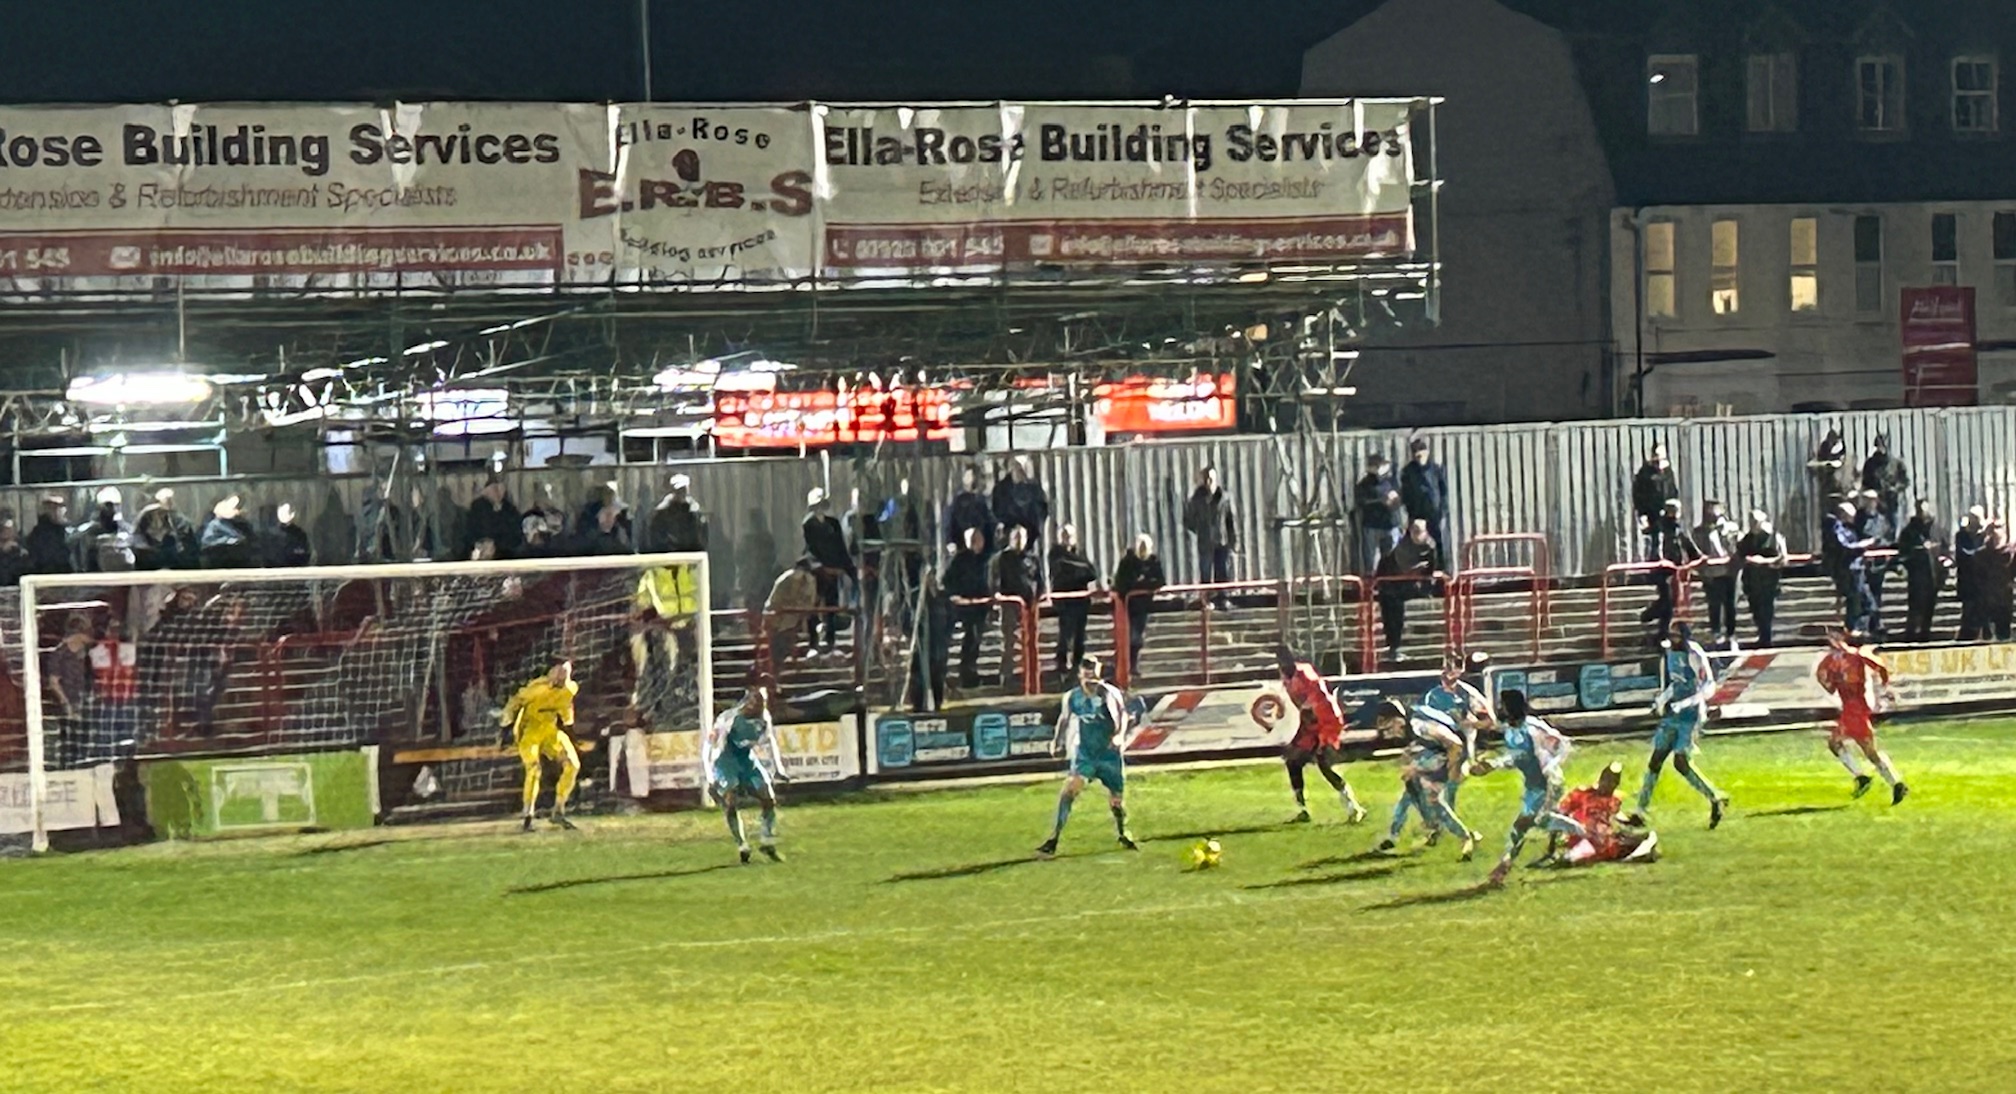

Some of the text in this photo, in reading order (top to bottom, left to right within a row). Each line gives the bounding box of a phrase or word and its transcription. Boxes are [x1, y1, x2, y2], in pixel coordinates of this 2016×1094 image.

[123, 123, 330, 177] Building
[349, 123, 561, 165] Services
[825, 122, 1402, 172] Ella-Rose Building Services
[109, 182, 128, 209] &
[1029, 176, 1045, 201] &
